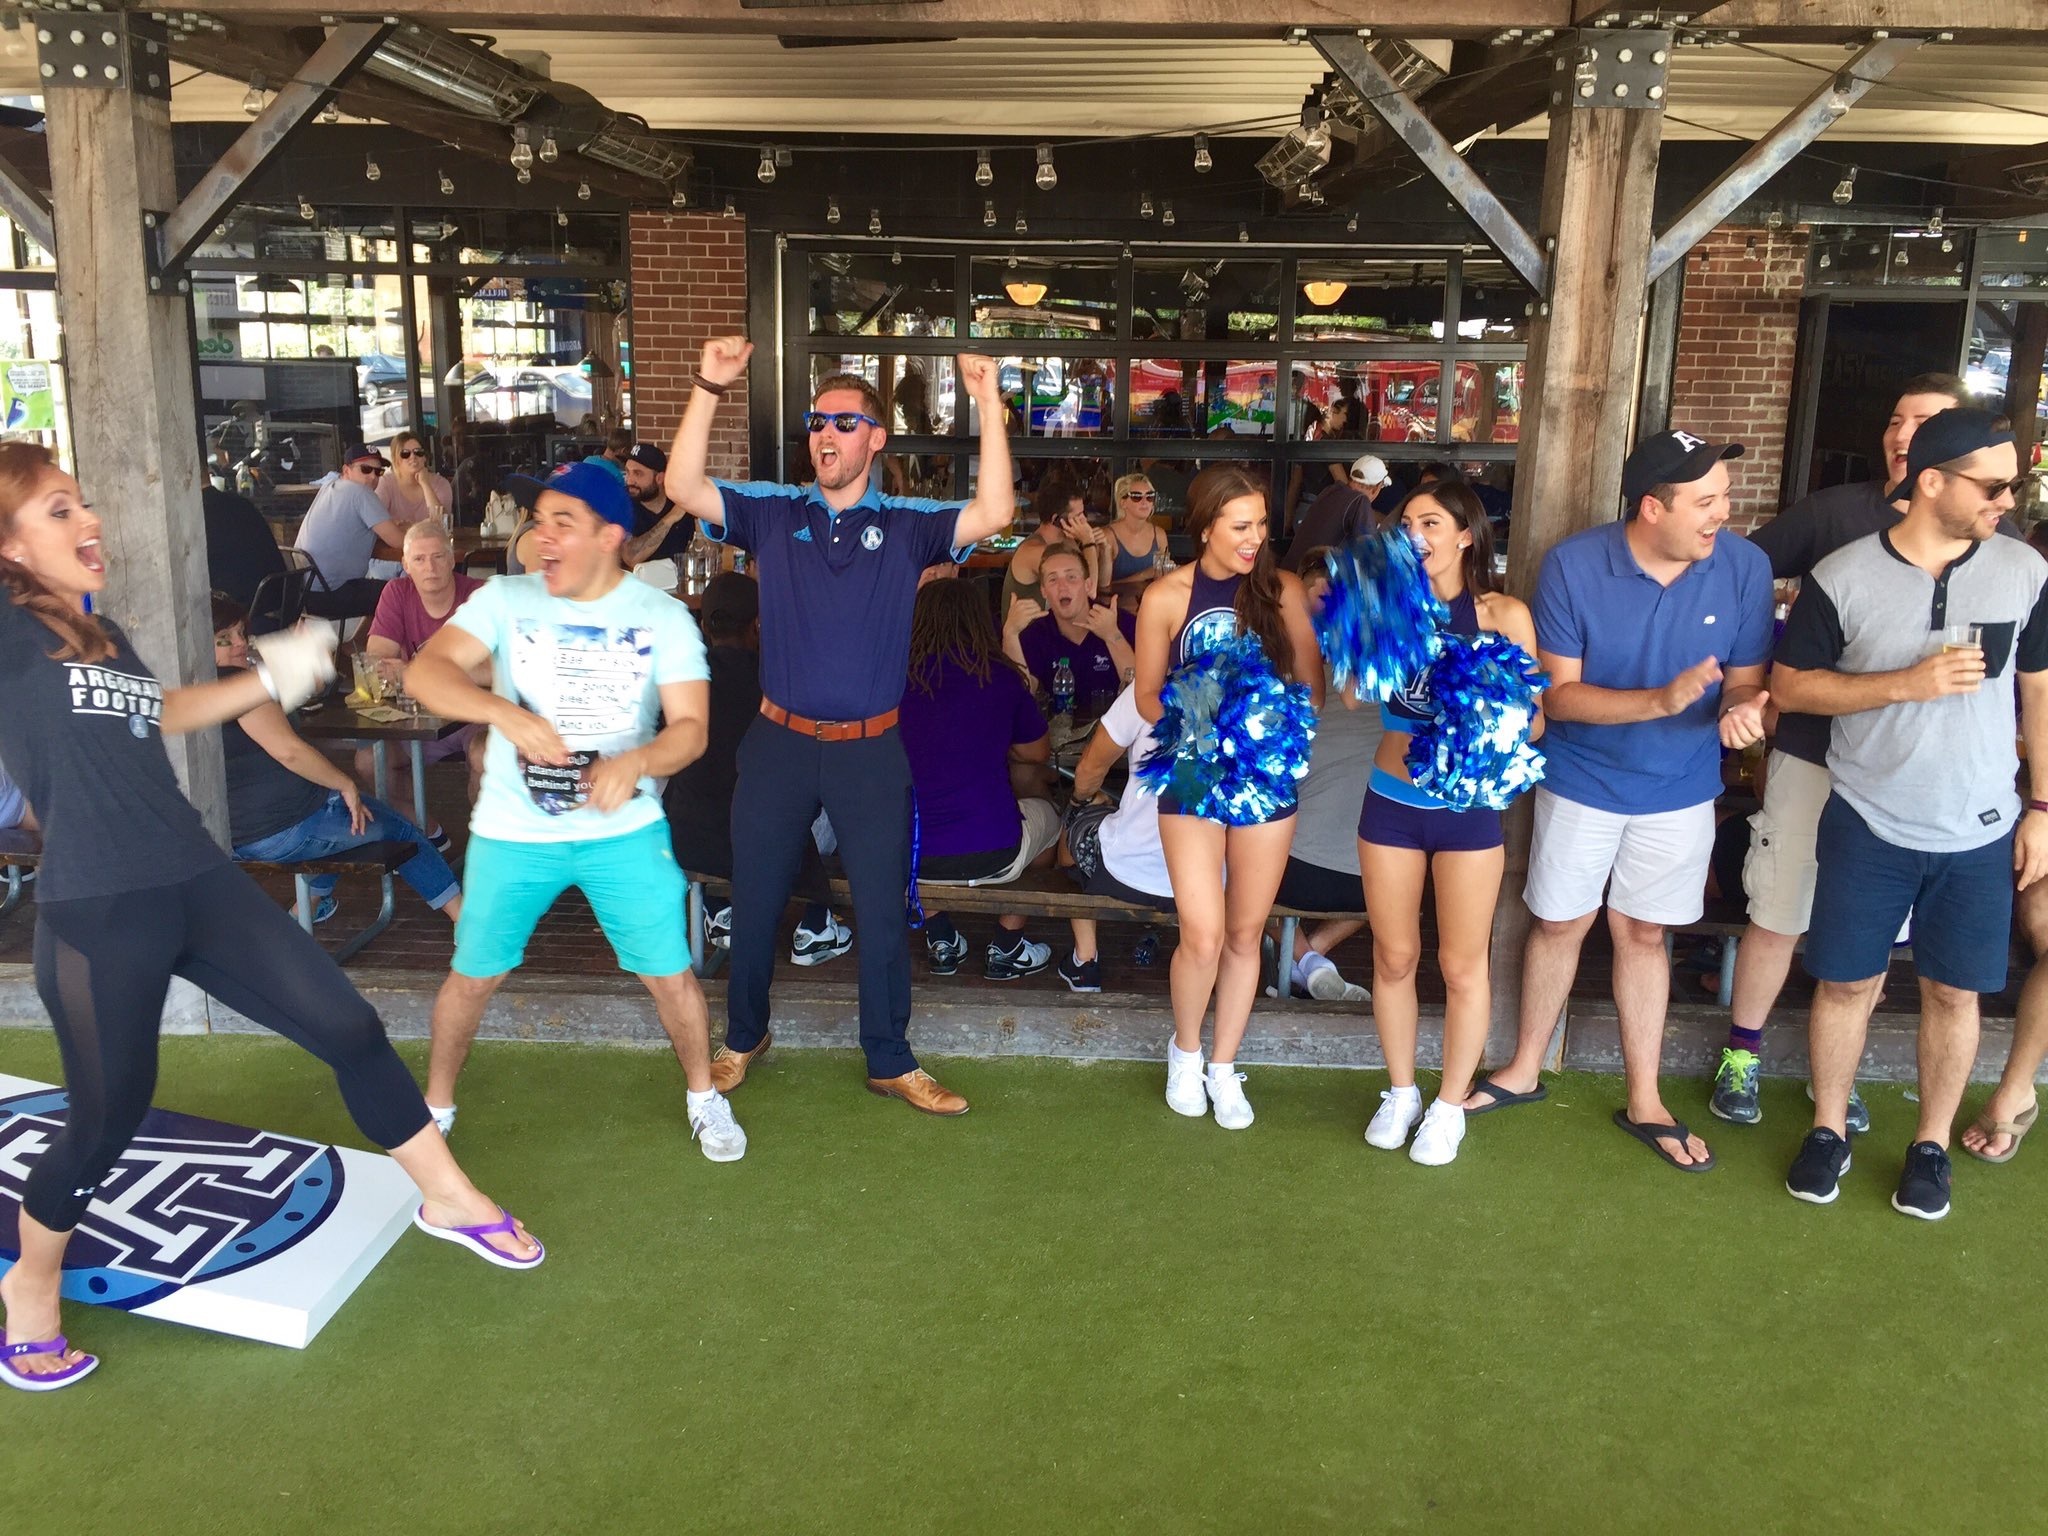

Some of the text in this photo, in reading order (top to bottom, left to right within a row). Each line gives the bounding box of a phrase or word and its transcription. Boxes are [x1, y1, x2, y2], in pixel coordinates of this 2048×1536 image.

[1671, 430, 1706, 453] A
[527, 765, 581, 780] standing
[527, 776, 571, 791] behind
